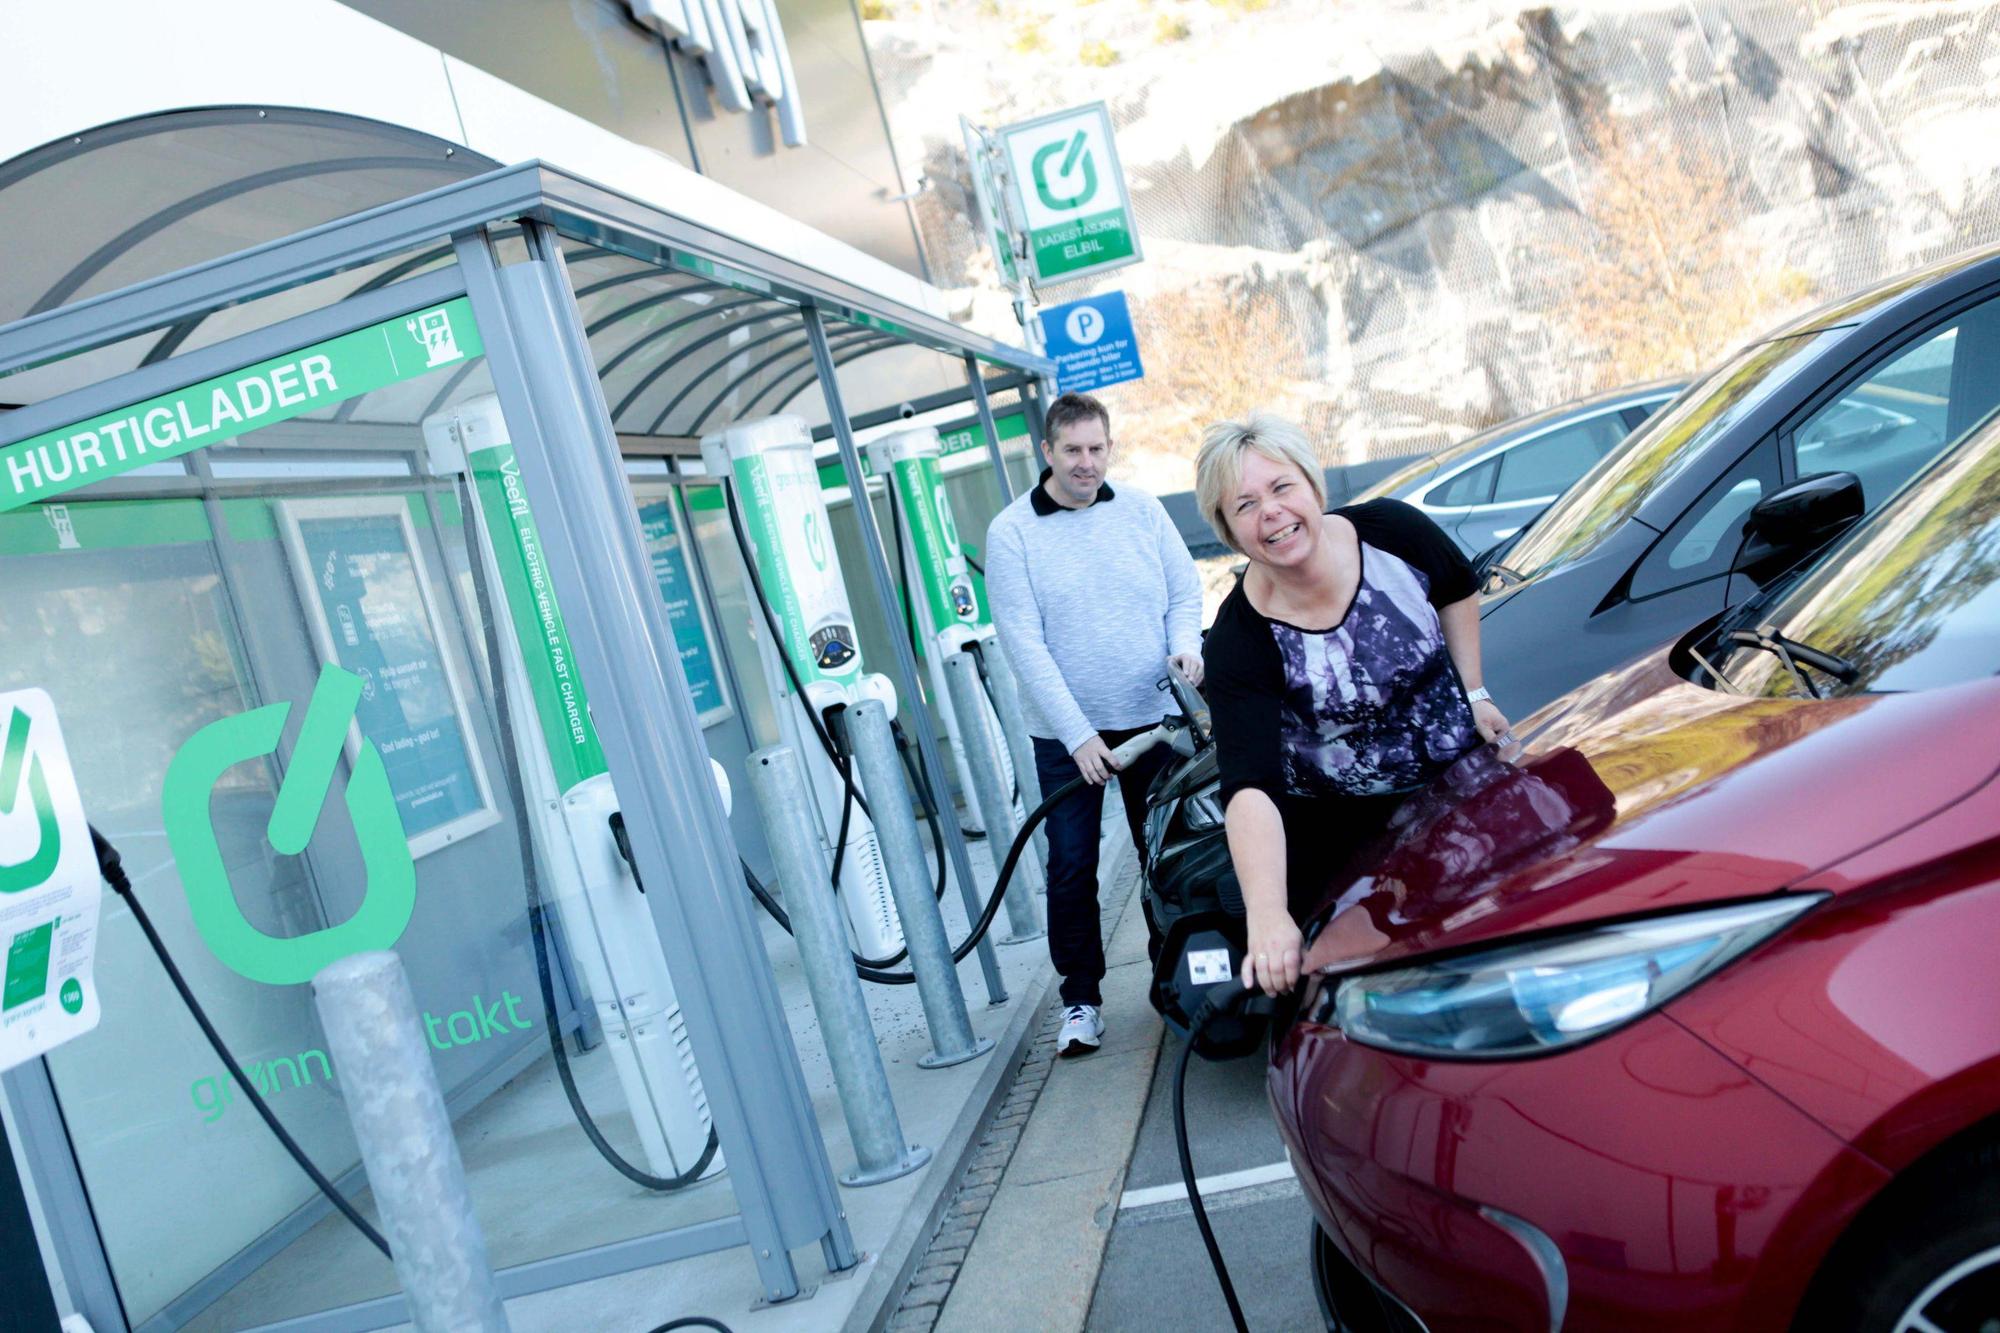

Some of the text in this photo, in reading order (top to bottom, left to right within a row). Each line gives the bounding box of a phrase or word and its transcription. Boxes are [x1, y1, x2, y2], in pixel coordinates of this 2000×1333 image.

[1039, 217, 1121, 248] LADESTASJON
[1063, 239, 1104, 259] ELBIL
[1078, 313, 1093, 337] P
[6, 353, 339, 494] HURTIGLADER
[500, 455, 585, 745] Veefil ELECTRIC VEHICLE FAST CHARGER
[191, 991, 533, 1124] grønn takt
